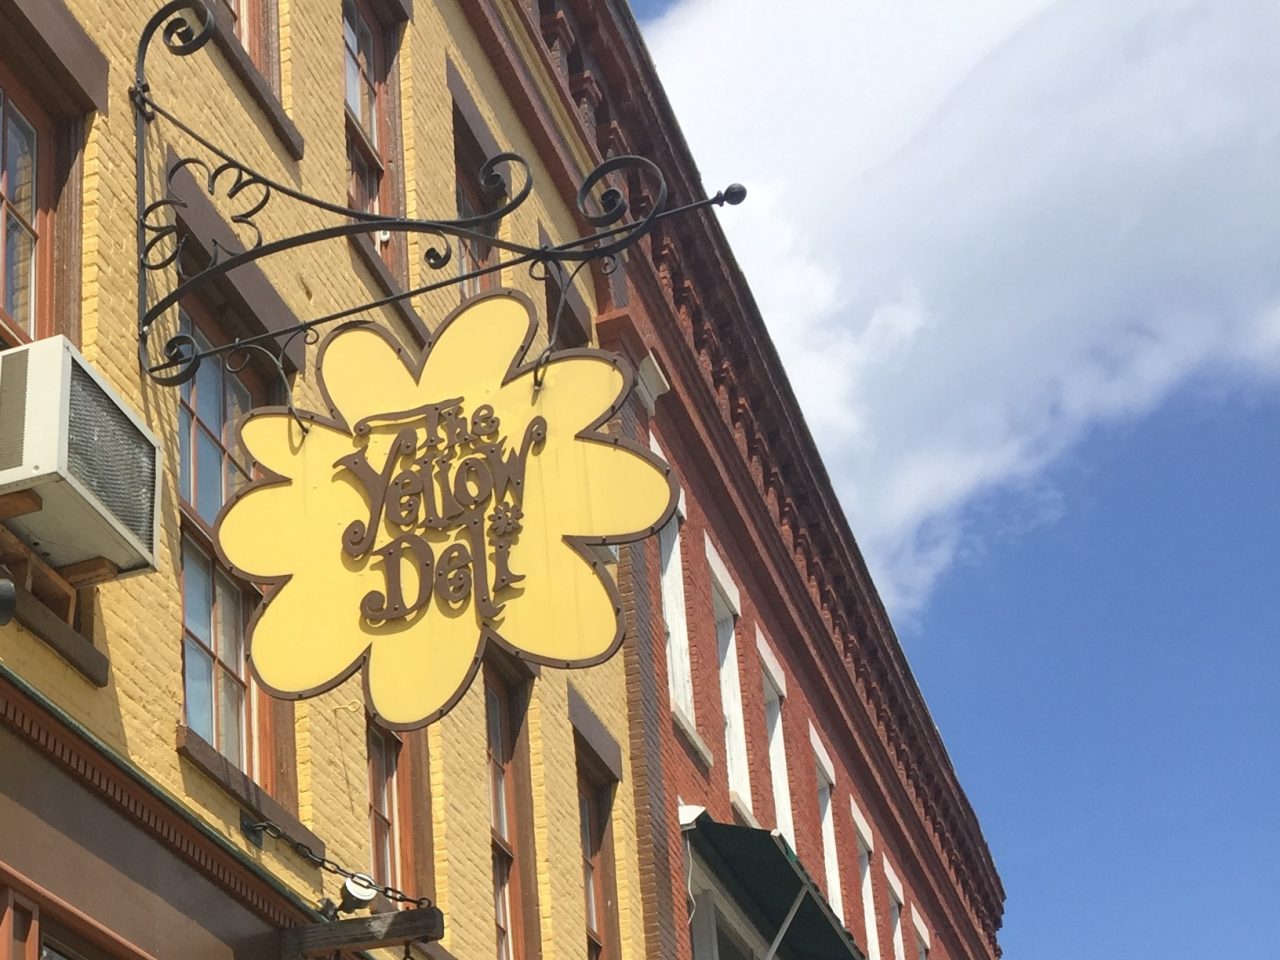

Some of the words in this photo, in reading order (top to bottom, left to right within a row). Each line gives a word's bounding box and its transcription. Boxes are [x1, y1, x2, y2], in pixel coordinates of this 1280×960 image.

[353, 396, 500, 451] The
[332, 416, 548, 557] Yellow
[360, 502, 526, 622] Deli
